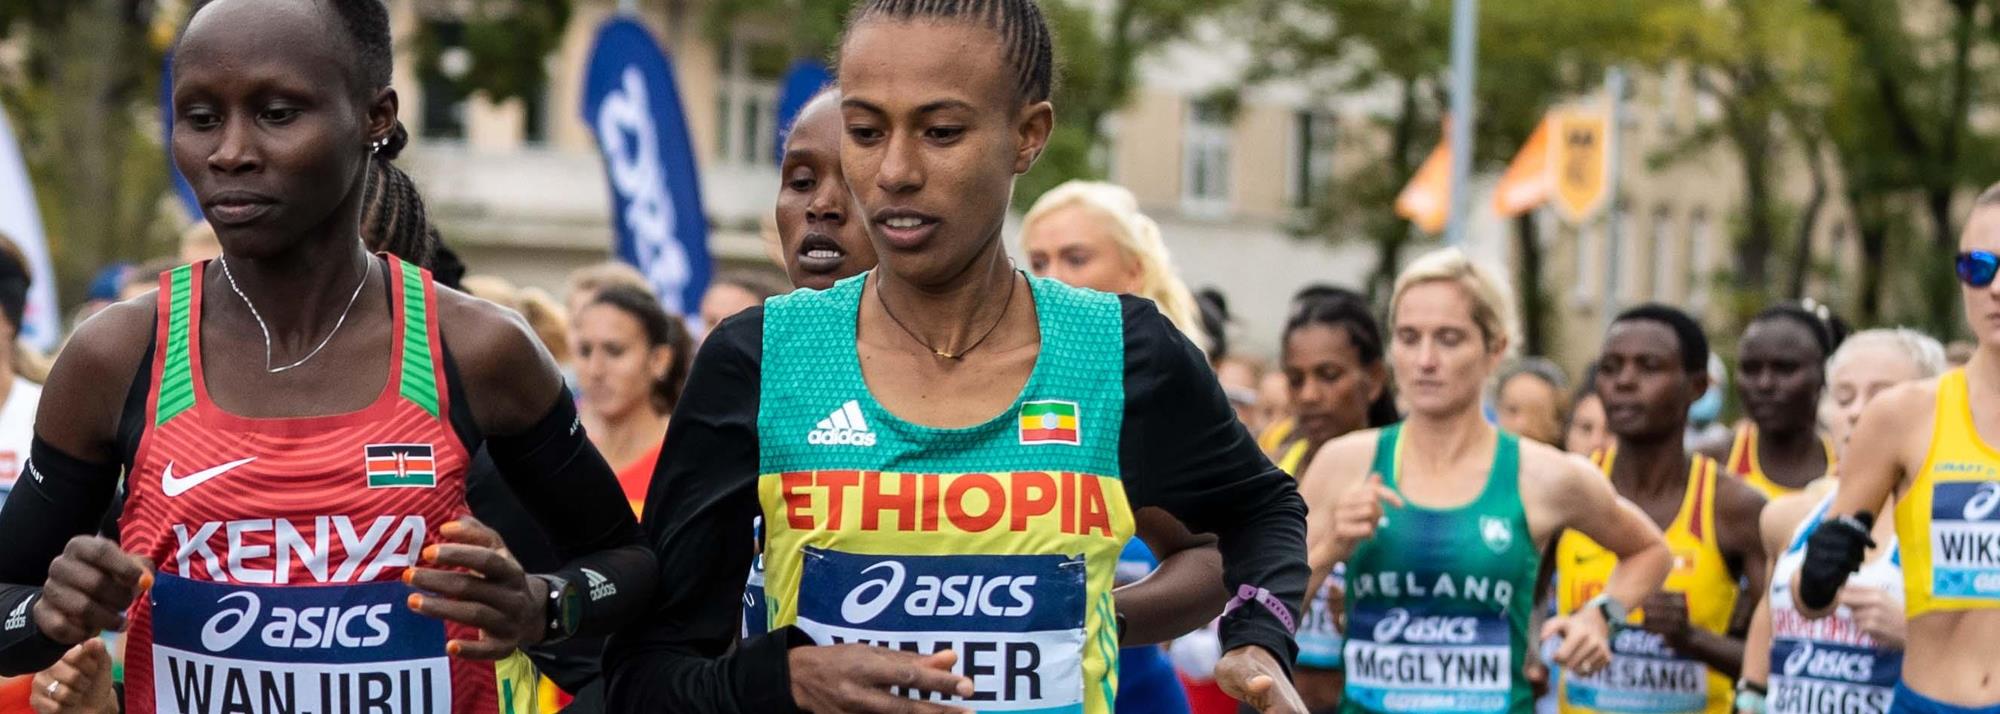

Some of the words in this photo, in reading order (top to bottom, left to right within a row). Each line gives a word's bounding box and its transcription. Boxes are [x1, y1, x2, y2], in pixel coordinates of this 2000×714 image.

[808, 428, 877, 447] adidas
[781, 470, 1113, 537] ETHIOPIA
[173, 515, 427, 584] KENYA
[590, 579, 617, 601] adidas
[904, 574, 1038, 617] asics
[5, 615, 26, 631] adidas
[261, 603, 392, 649] asics
[1404, 616, 1479, 643] asics
[1354, 650, 1499, 685] McGLYNN
[1807, 648, 1876, 683] asics
[1774, 682, 1884, 714] BRIGGS
